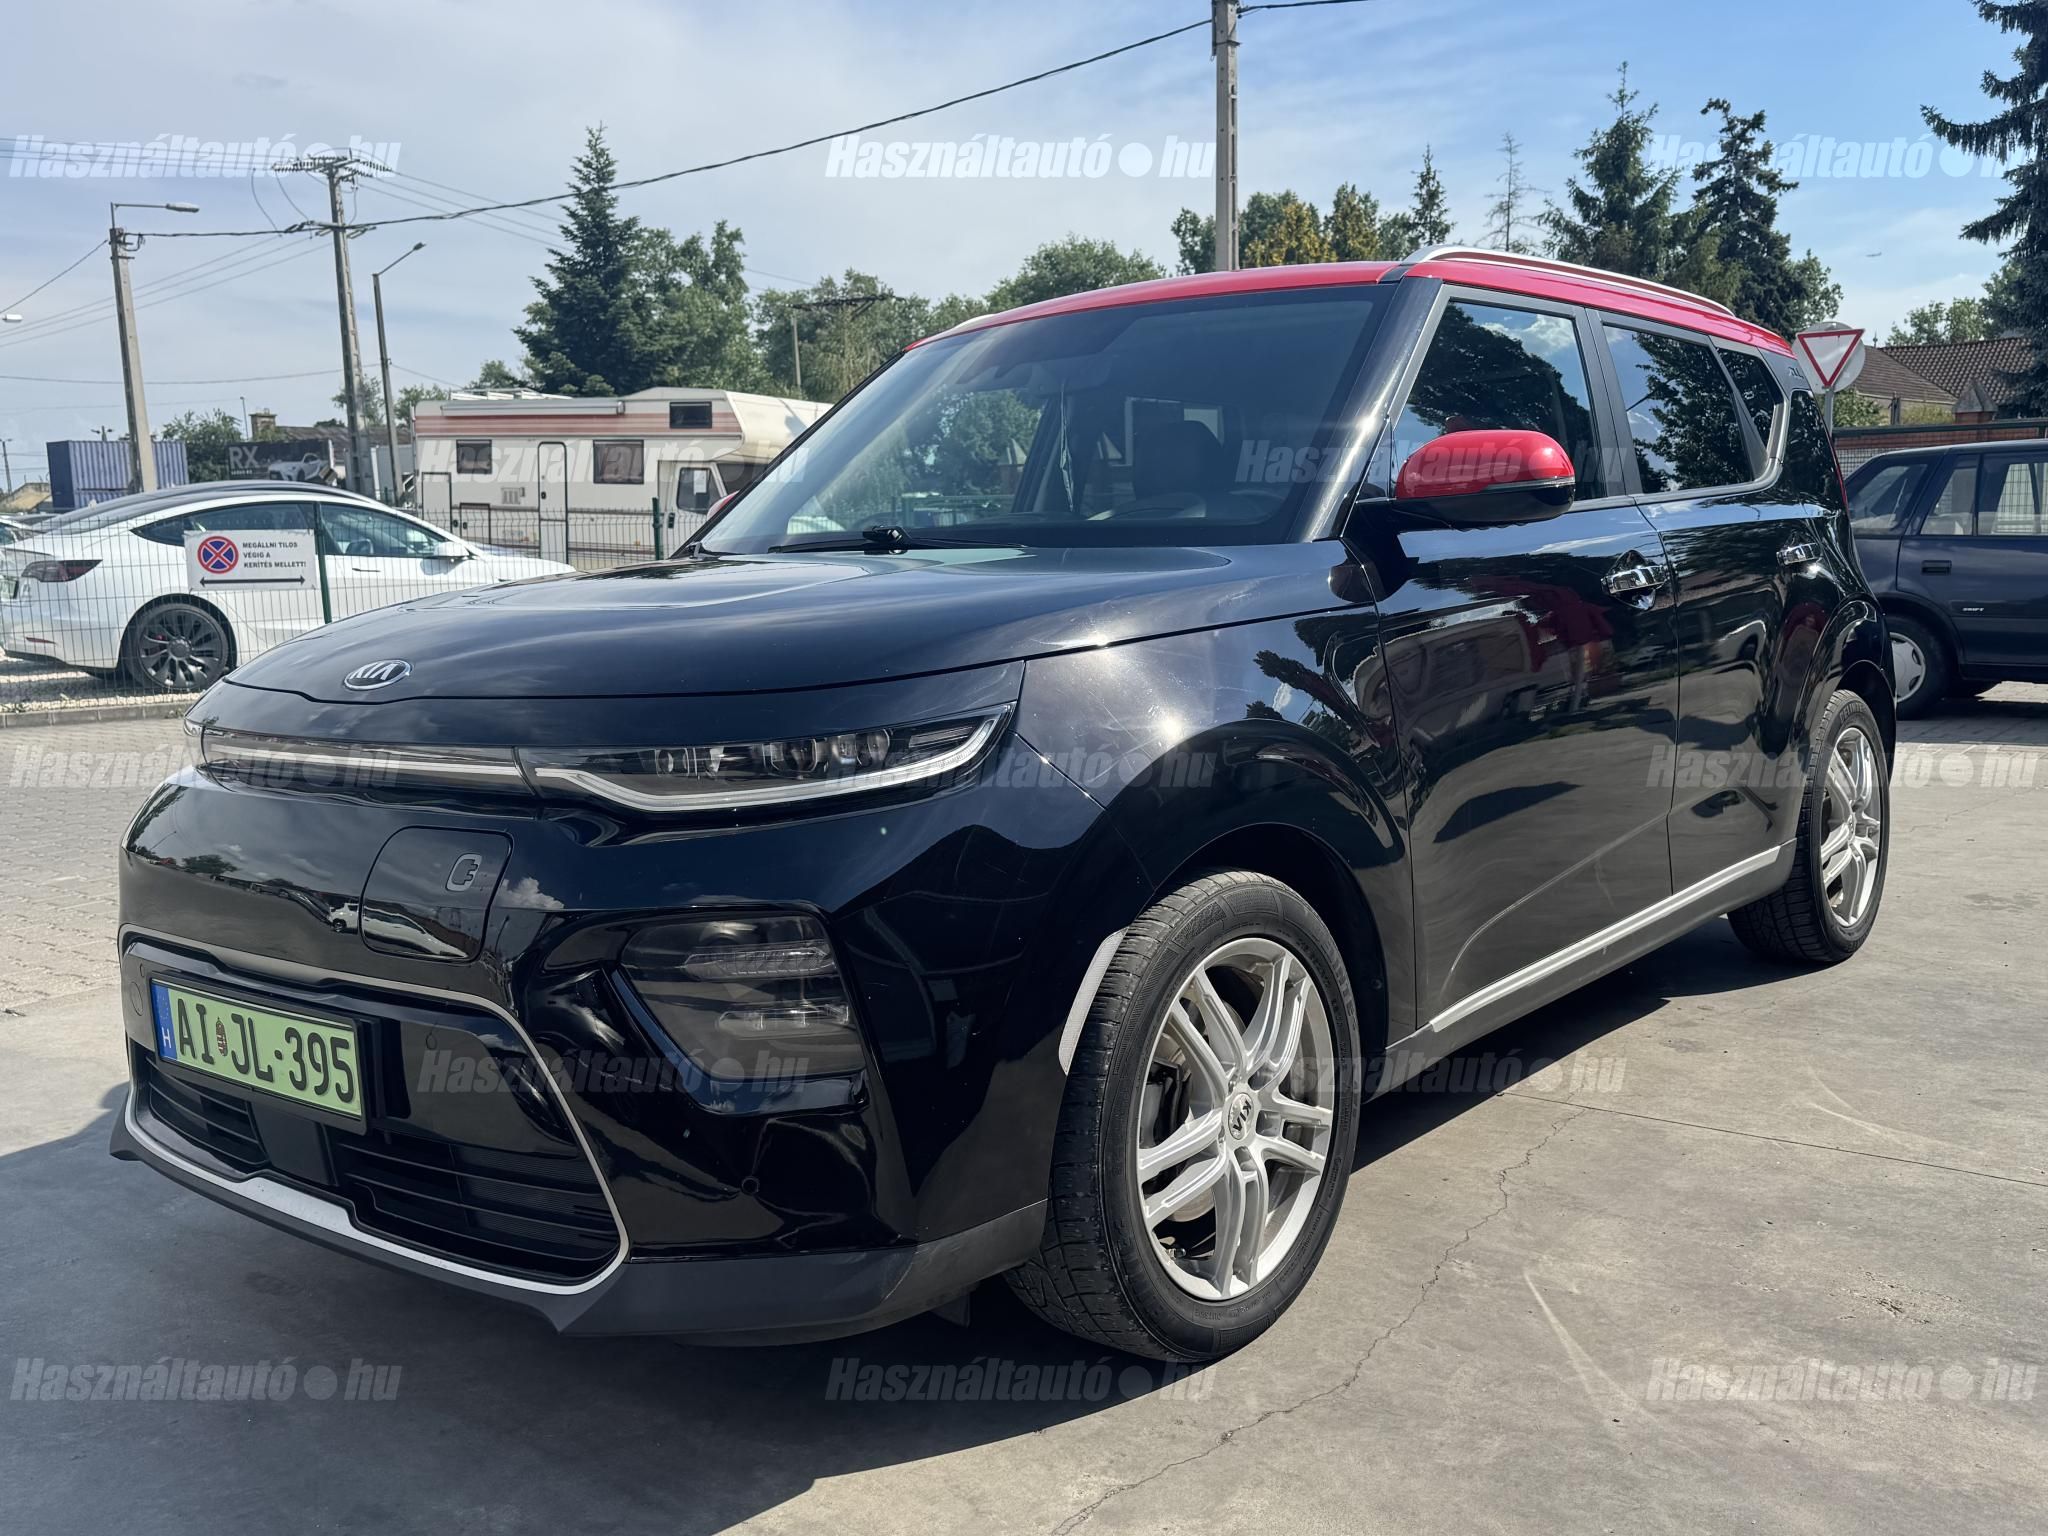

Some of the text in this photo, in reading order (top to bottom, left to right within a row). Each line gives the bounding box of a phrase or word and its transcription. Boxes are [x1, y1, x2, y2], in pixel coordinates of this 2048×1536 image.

[229, 446, 259, 469] RX
[242, 540, 298, 549] MEGÁLLNI TILOS
[243, 551, 265, 559] VÉGIG
[244, 560, 273, 569] KERÍTÉS
[162, 1026, 172, 1049] H
[177, 998, 215, 1065] AI
[1233, 1099, 1252, 1131] KIA
